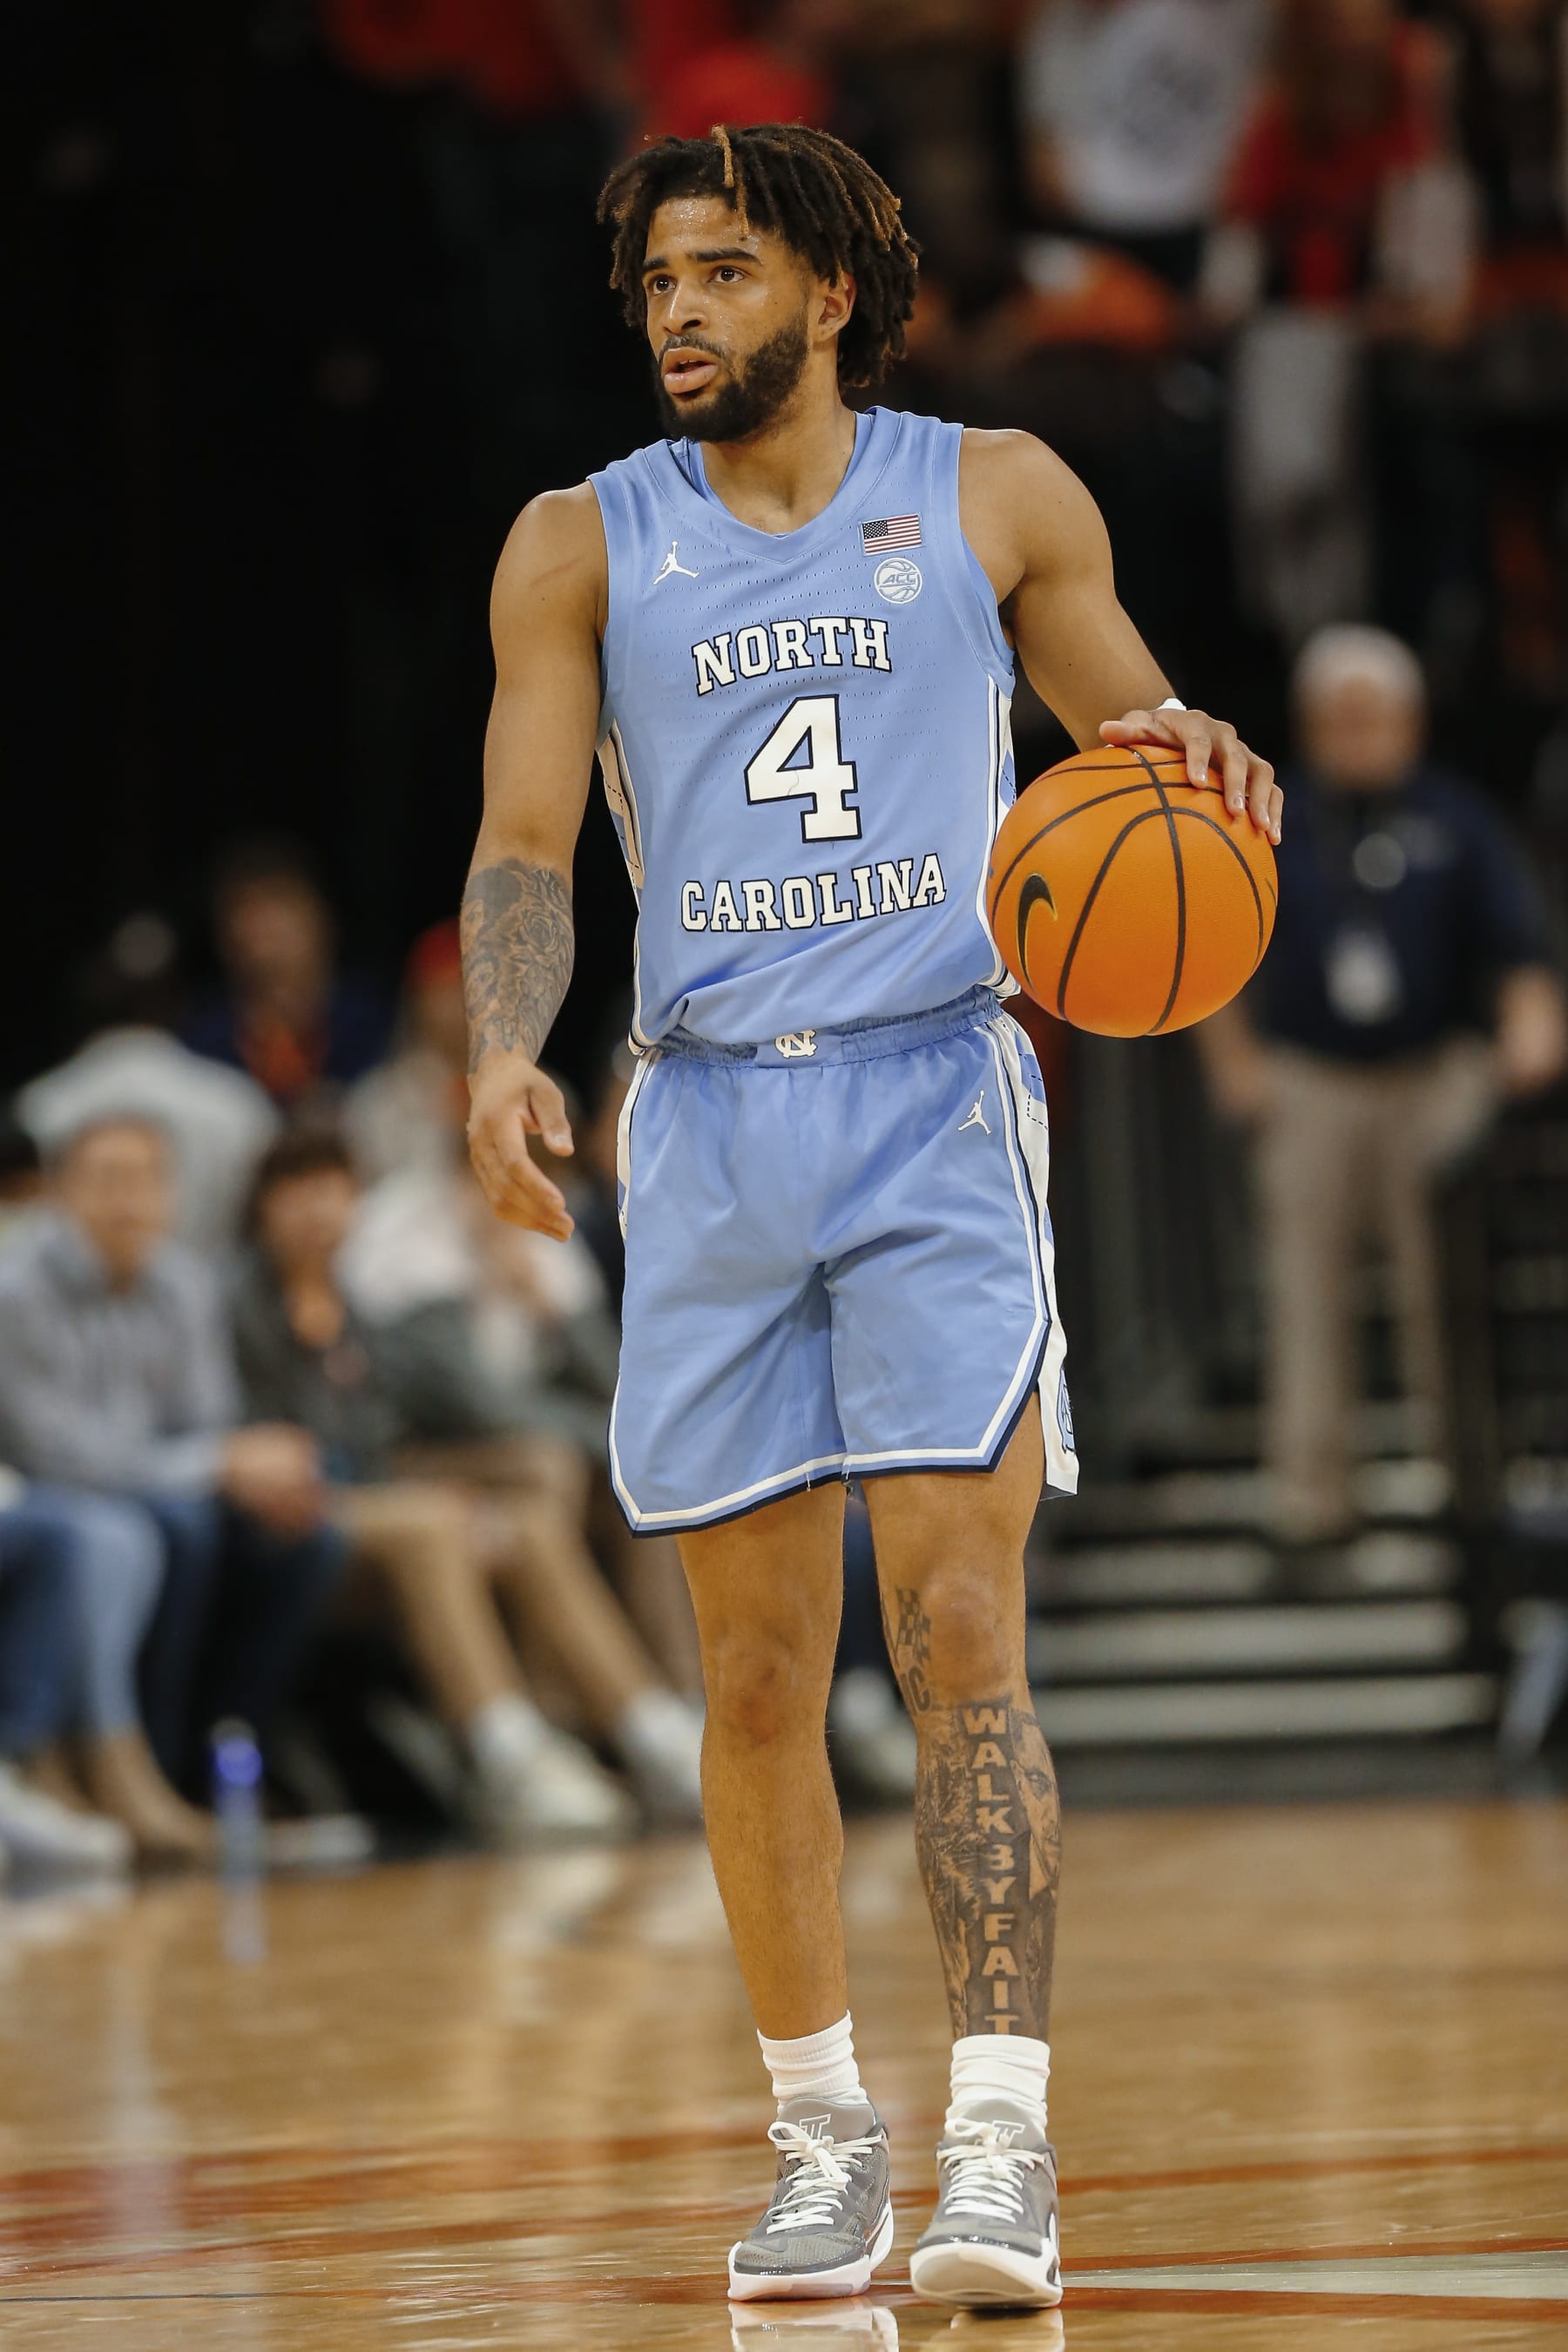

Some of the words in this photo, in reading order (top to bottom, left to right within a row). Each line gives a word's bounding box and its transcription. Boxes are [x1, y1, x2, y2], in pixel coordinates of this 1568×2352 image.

[881, 571, 917, 585] ACC
[692, 616, 892, 696] NORTH
[743, 693, 862, 843] 4
[680, 853, 947, 932] CAROLINA
